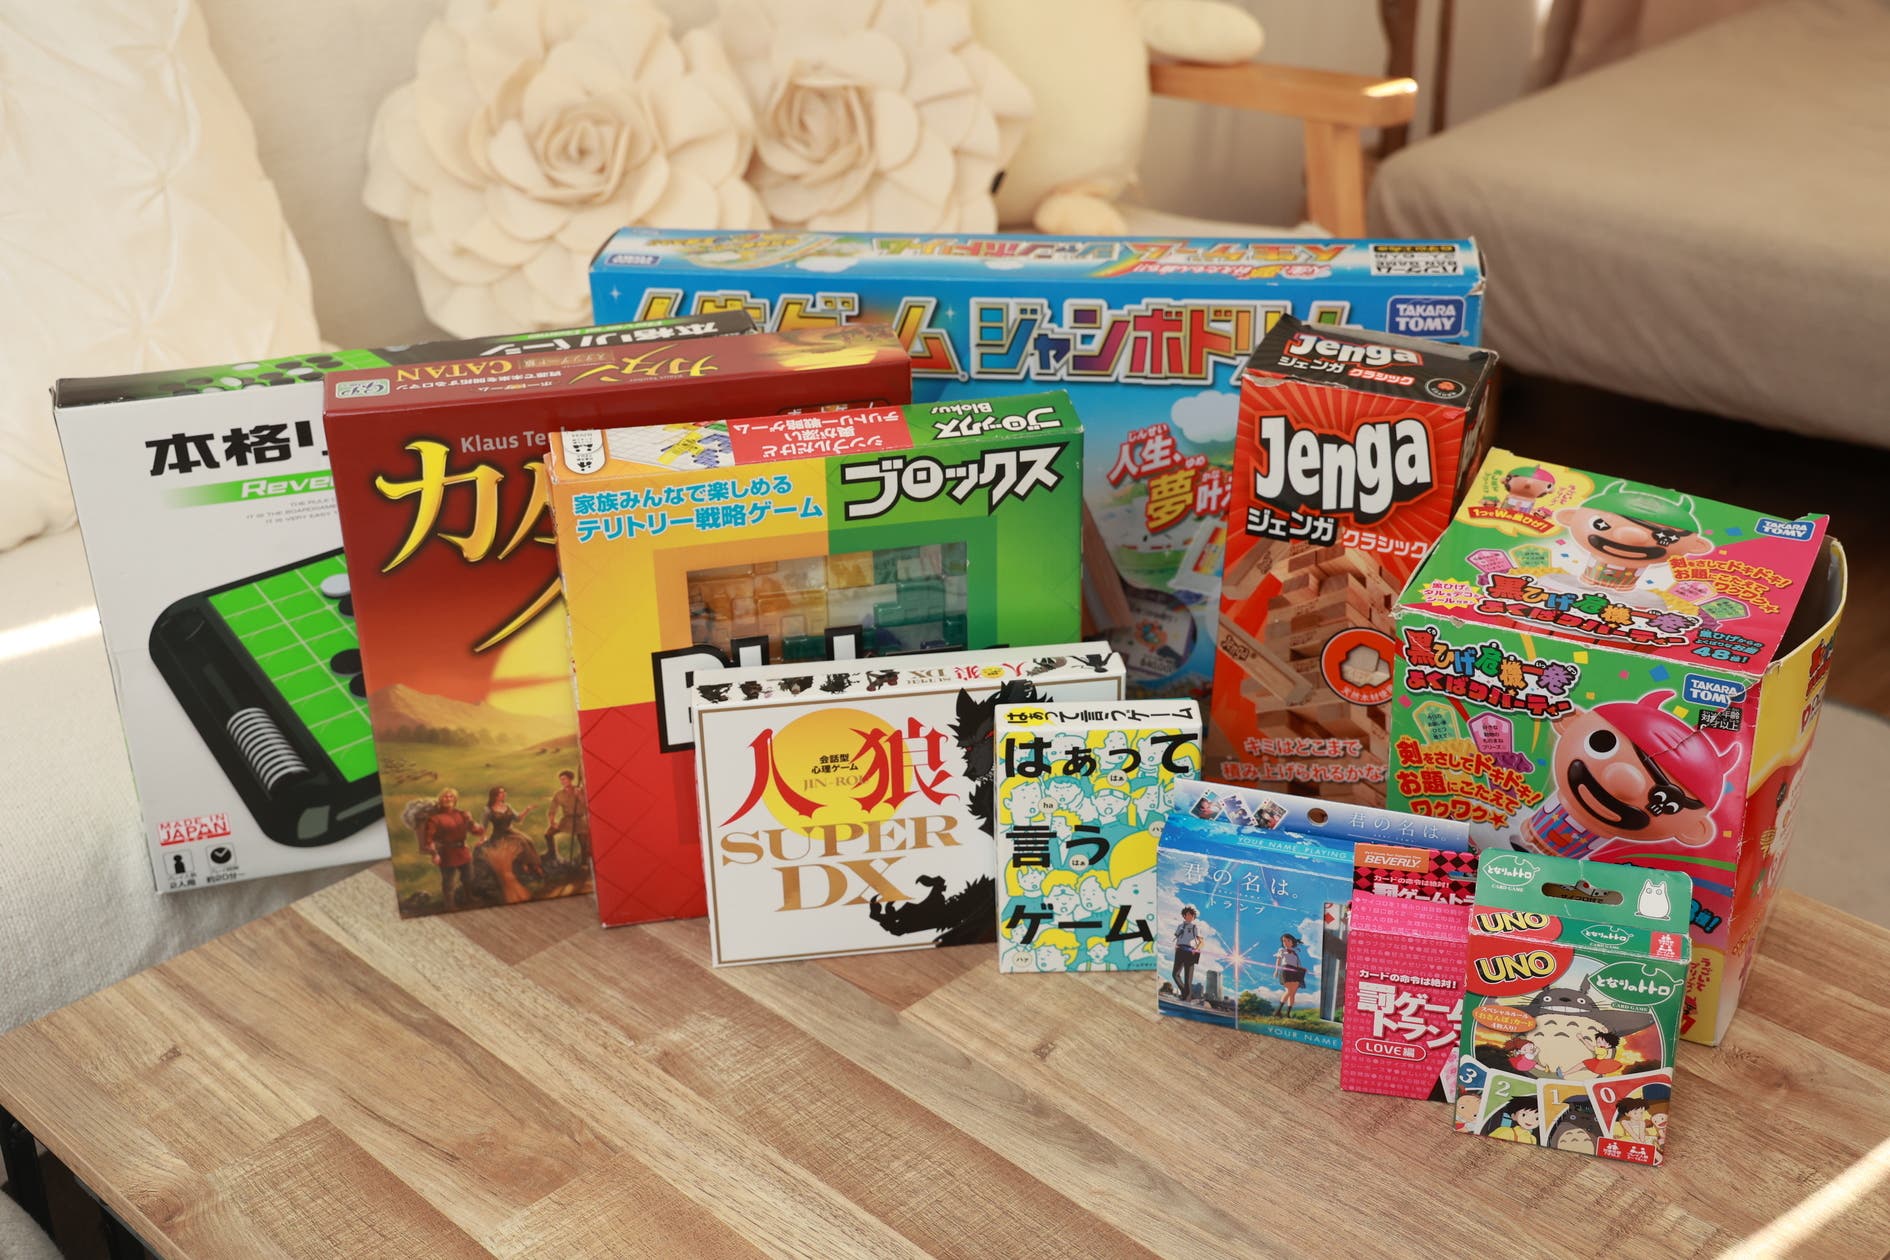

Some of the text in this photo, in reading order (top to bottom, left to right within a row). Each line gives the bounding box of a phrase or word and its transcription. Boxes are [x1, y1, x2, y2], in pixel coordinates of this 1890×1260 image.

[1396, 304, 1456, 318] TAKARA
[1397, 317, 1453, 331] TOMY
[479, 321, 718, 356] 本格リバーシ
[1289, 334, 1420, 366] Jenga
[396, 360, 512, 381] CATAN
[569, 344, 719, 384] カタン
[1278, 356, 1416, 386] ジェンガ クラシック
[930, 402, 993, 414] Blokus
[733, 410, 900, 435] テリトリー戦略ゲーム
[785, 425, 856, 441] 奥が深い
[933, 405, 1062, 440] ブロックス
[461, 434, 519, 453] Klaus
[762, 434, 884, 458] シンプルだけど
[1256, 416, 1432, 515] Jenga
[841, 442, 1070, 521] ブロックス
[573, 474, 793, 515] 家族みんなで楽しめる
[577, 496, 824, 543] テリトリー戦略ゲーム
[1763, 520, 1808, 531] TAKARA
[1247, 507, 1428, 559] ジェンガ クラシック
[1762, 527, 1806, 538] TOMY
[1690, 679, 1738, 695] TAKARA
[1007, 706, 1194, 724] はぁって言うゲーム
[819, 753, 850, 764] 会話型
[1004, 733, 1198, 778] はぁって
[1244, 738, 1362, 758] キミはどこまで
[719, 716, 961, 828] 人狼
[811, 763, 859, 774] 心理ゲーム
[1395, 739, 1543, 806] 剣をさしてドキドキ!
[803, 775, 865, 791] JIN-RO
[1395, 770, 1522, 815] お題にこたえて
[1042, 801, 1053, 809] ha
[1410, 798, 1489, 823] ワクワク
[160, 813, 225, 830] MADE IN
[163, 821, 228, 842] JAPAN
[720, 813, 961, 866] SUPER
[1005, 825, 1110, 868] 言う
[1237, 836, 1348, 859] YOUR NAME PLAYING
[1364, 854, 1421, 868] BEVERLY
[1184, 861, 1298, 899] 君の名は。
[1373, 875, 1450, 889] カードの命令は絶対!
[1487, 866, 1532, 879] となりのトトロ
[774, 856, 916, 912] DX
[1005, 903, 1155, 944] ゲーム
[1477, 911, 1551, 934] UNO
[1474, 950, 1557, 984] UNO
[1359, 969, 1457, 989] カードの命令は絶対!
[1596, 975, 1672, 997] となりのトトロ
[1267, 1027, 1338, 1047] YOUR NAME
[1373, 1010, 1461, 1049] トラン
[1459, 1067, 1478, 1084] 3
[1494, 1081, 1512, 1097] 2
[1551, 1088, 1562, 1105] 1
[1599, 1087, 1617, 1105] 0
